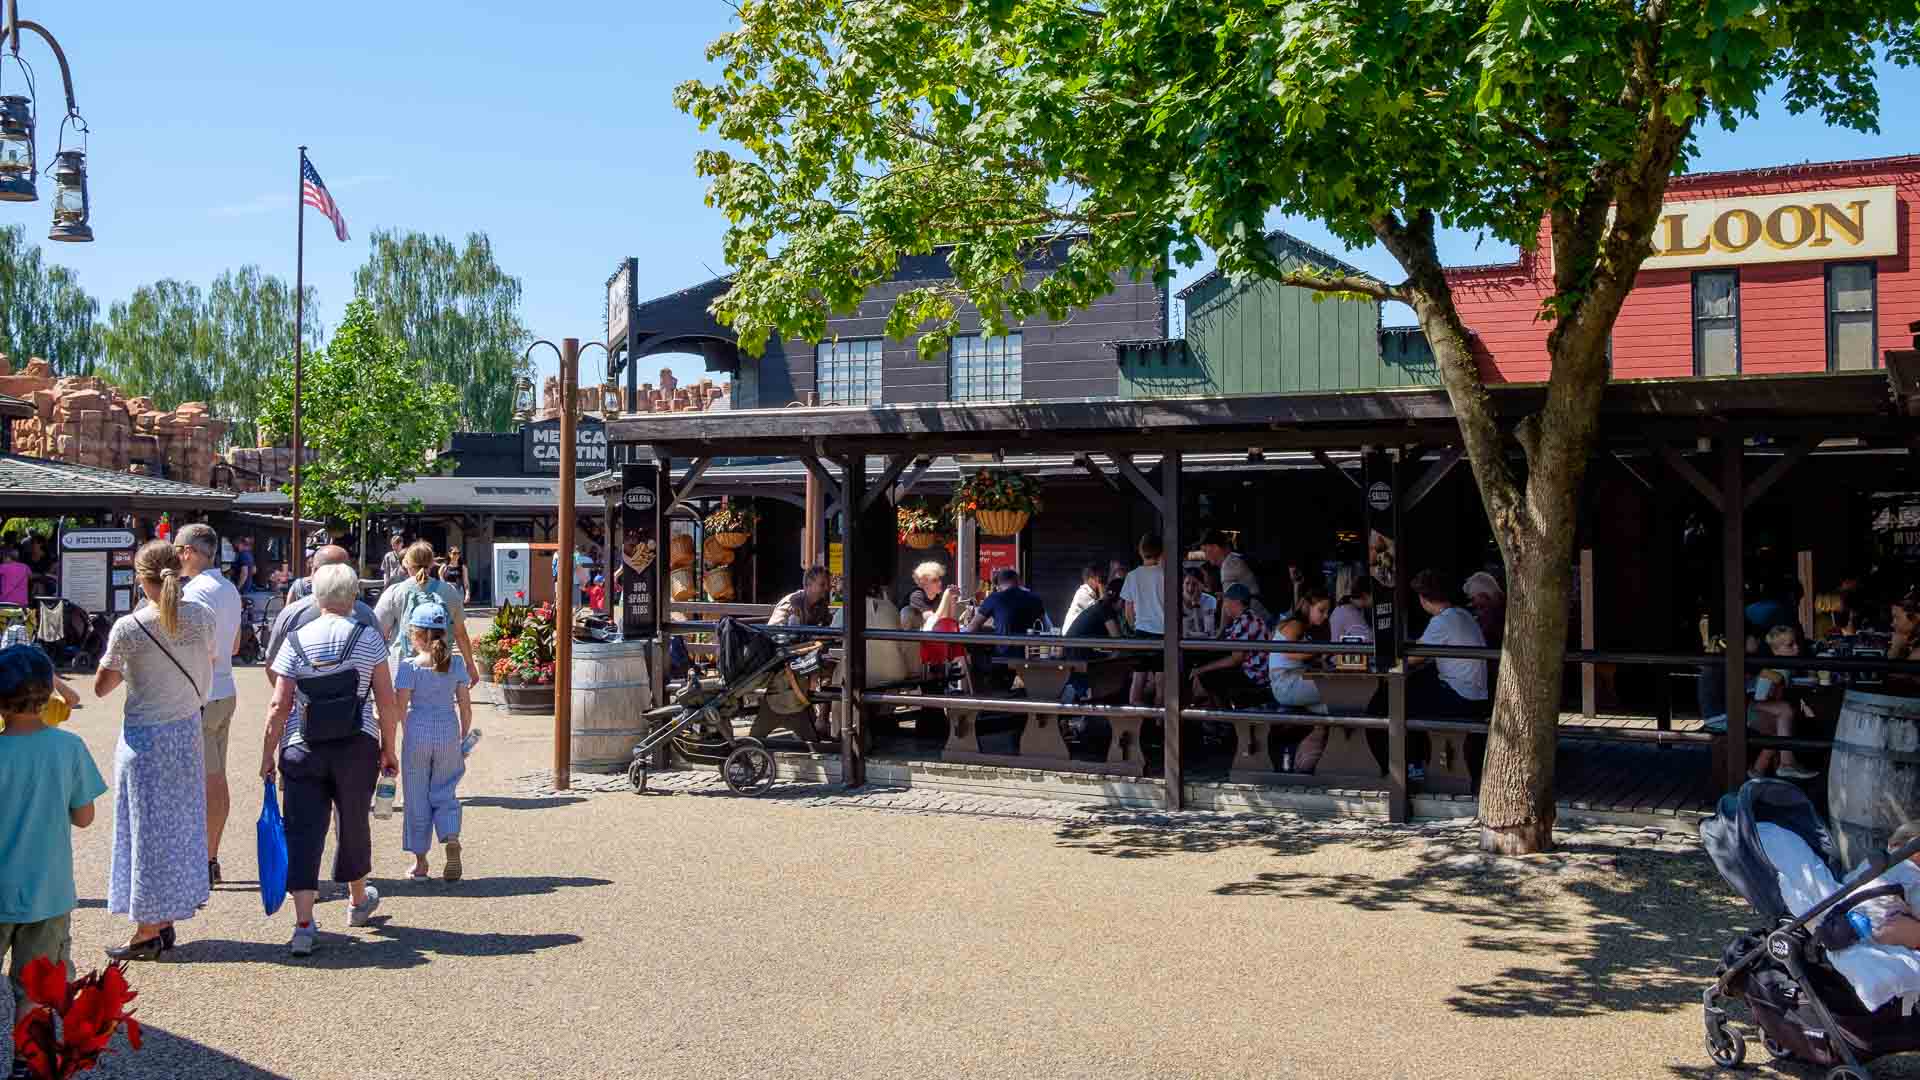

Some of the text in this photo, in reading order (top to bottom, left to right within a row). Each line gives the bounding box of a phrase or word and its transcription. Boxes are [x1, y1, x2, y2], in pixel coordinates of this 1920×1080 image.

[1650, 199, 1870, 257] LOON
[628, 494, 651, 503] SALOON
[633, 582, 647, 592] BBQ
[628, 593, 649, 603] SPARE
[632, 605, 648, 614] RIBS
